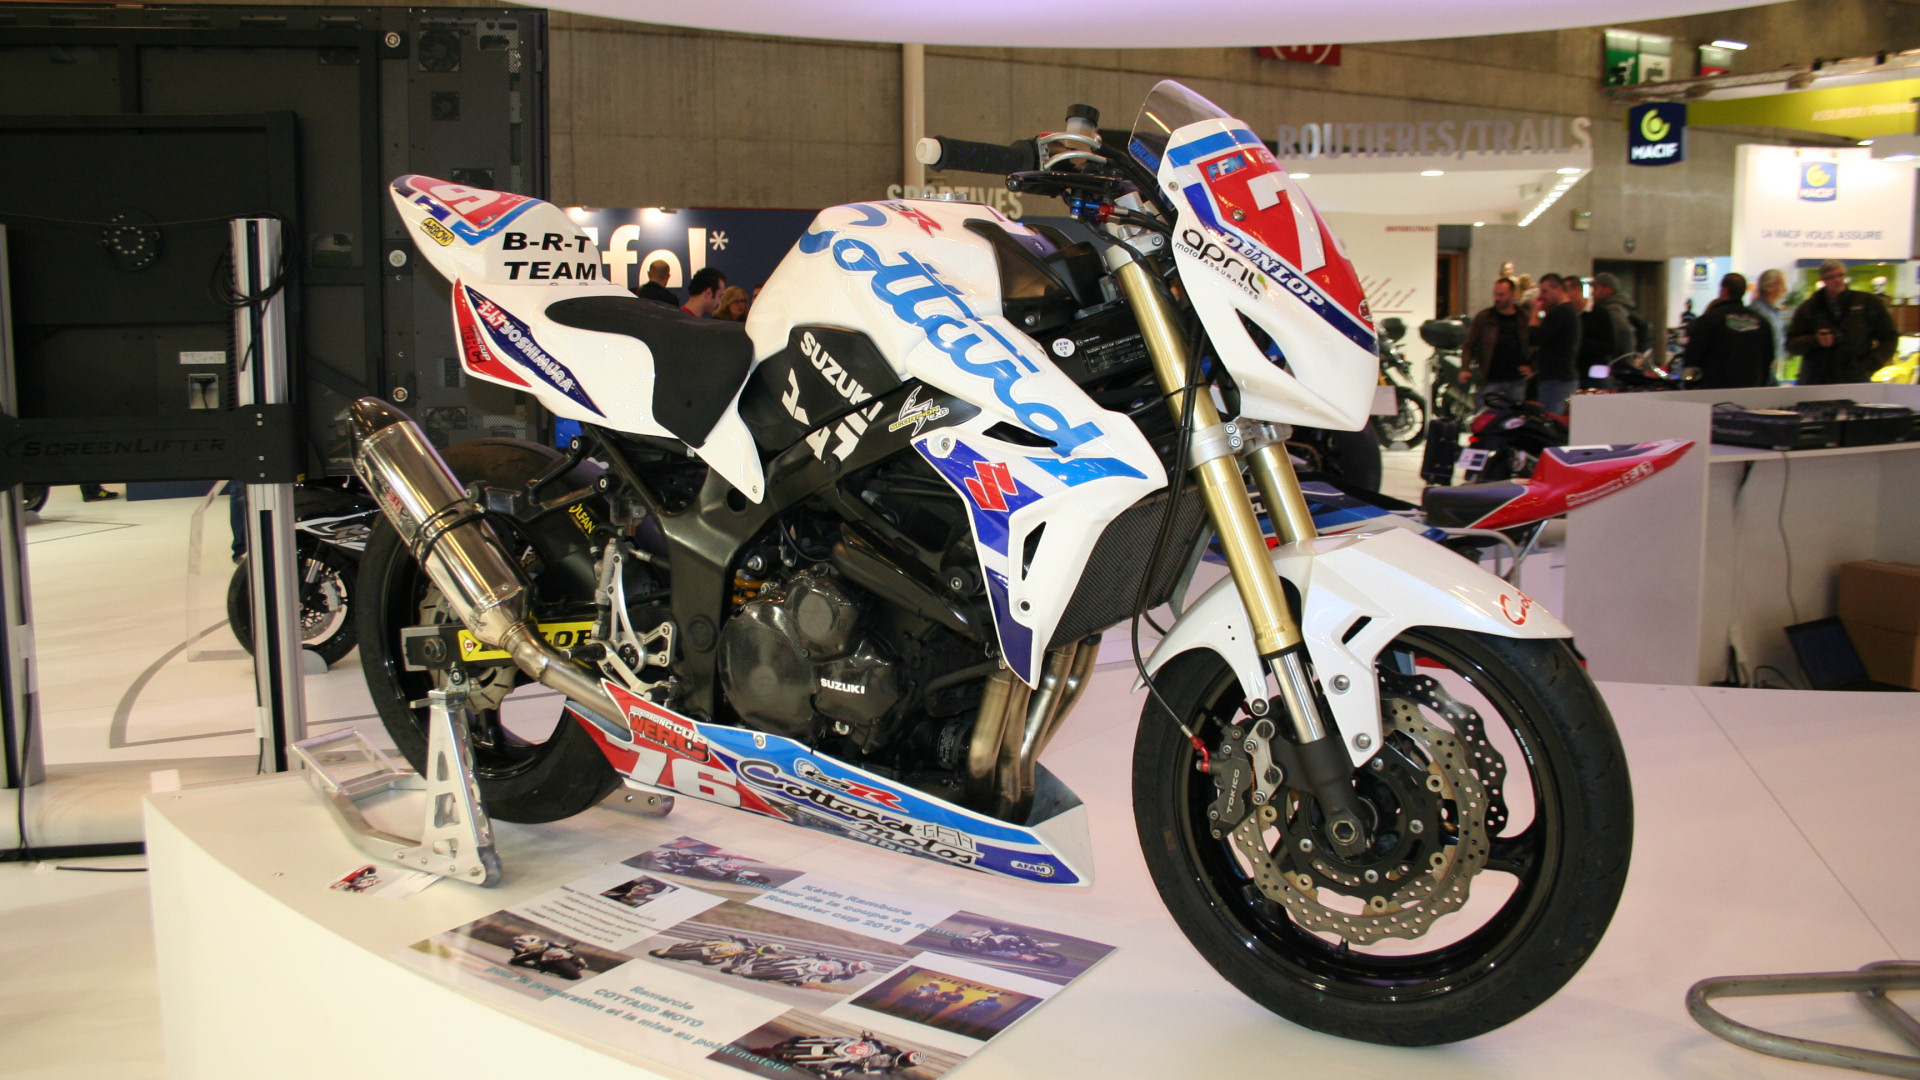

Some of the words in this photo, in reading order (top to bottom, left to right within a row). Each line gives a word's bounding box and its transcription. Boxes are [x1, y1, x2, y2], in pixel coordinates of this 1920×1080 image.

[1207, 153, 1248, 179] FFM
[1631, 142, 1679, 160] MACIF
[423, 220, 453, 245] ARROW
[1247, 171, 1327, 274] 7
[502, 231, 591, 253] B-R-T
[504, 261, 597, 281] TEAM
[1174, 241, 1199, 259] moto
[1202, 258, 1260, 301] ASSURANCES
[1219, 231, 1325, 307] DUNLOP
[498, 319, 576, 393] YOSHIMURA
[800, 331, 884, 422] SUZUKI
[820, 677, 865, 694] SUZUKI
[605, 735, 742, 808] 76
[1225, 768, 1242, 815] TOKICO
[1016, 862, 1046, 873] AFAM
[832, 912, 860, 923] cup
[862, 919, 902, 933] 2013
[594, 988, 660, 1013] COTTARD
[659, 1009, 704, 1028] MOTO
[630, 985, 695, 1010] Remercie
[605, 1007, 624, 1016] et
[622, 1012, 638, 1022] la
[637, 1018, 674, 1034] mise
[673, 1030, 695, 1041] au
[692, 1037, 736, 1054] point
[735, 1051, 792, 1072] moteur
